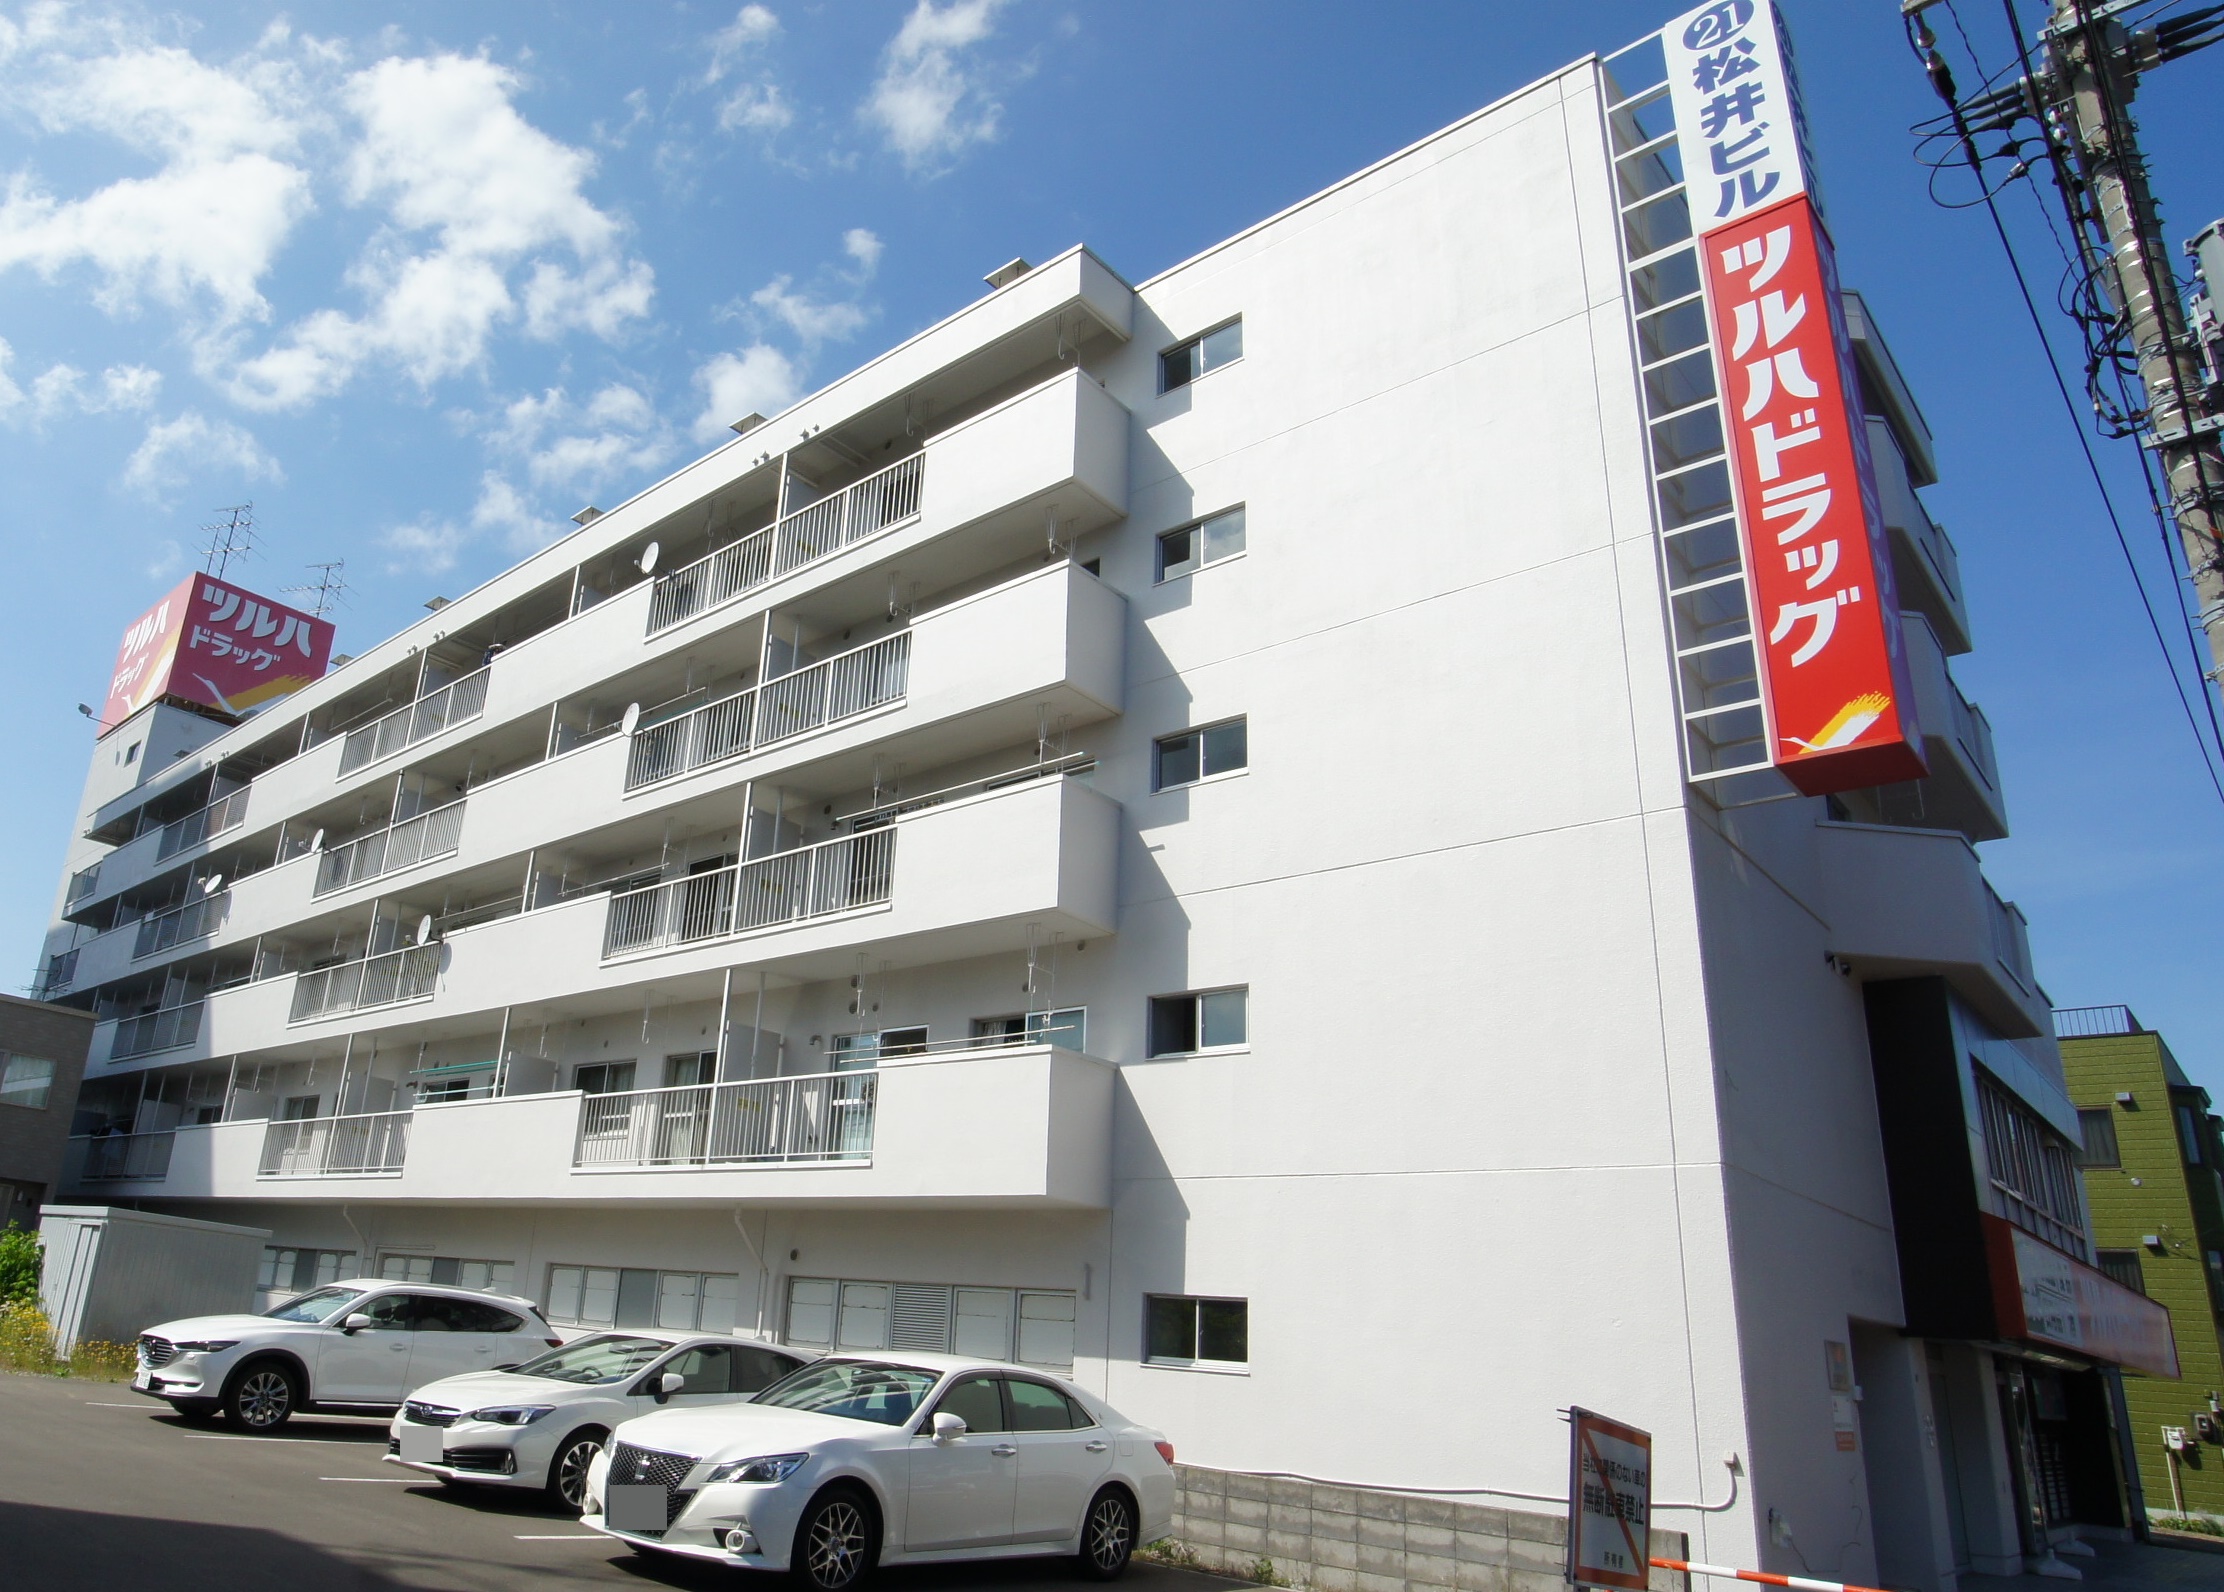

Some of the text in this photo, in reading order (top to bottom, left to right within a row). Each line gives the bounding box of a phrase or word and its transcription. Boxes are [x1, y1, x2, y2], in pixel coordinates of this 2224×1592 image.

[1692, 1, 1746, 49] 21
[1693, 37, 1781, 218] 松井ビル
[1720, 225, 1861, 668] ツルハドラッグ
[123, 600, 171, 664] ツルハ
[189, 624, 281, 671] ドラッグ
[202, 583, 312, 659] ツルハ
[110, 652, 150, 700] ドラッグ
